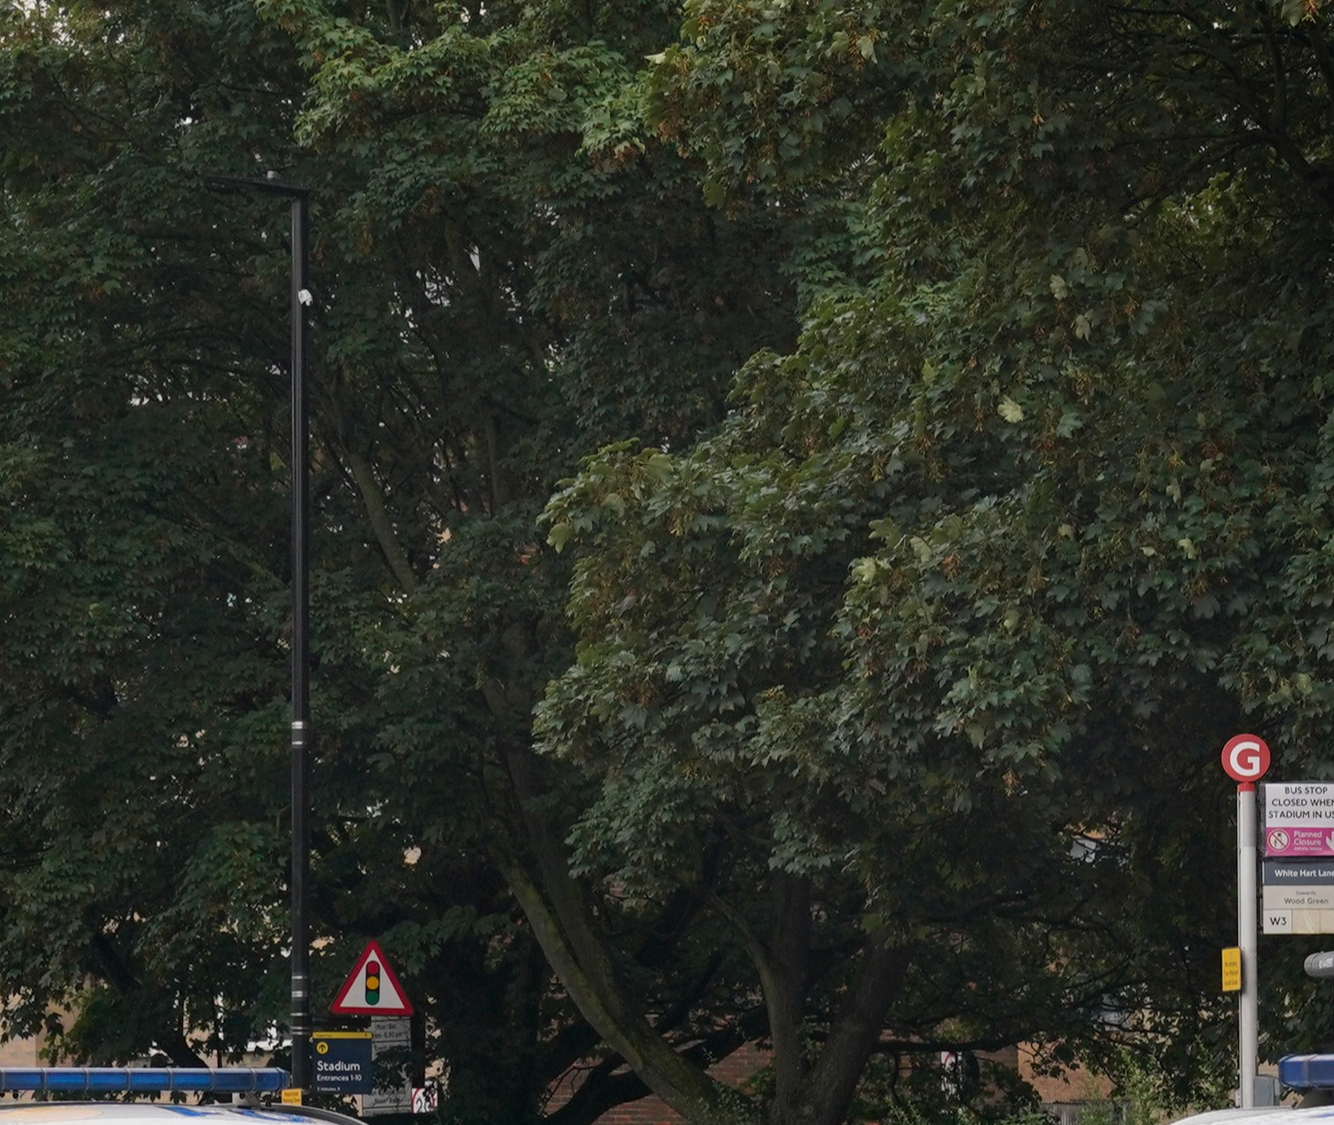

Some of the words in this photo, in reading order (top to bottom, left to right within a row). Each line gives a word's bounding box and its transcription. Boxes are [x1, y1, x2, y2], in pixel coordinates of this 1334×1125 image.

[1230, 741, 1260, 777] G
[1284, 786, 1302, 794] BUS
[1304, 786, 1328, 794] STOP
[1271, 798, 1308, 807] CLOSED
[1268, 810, 1310, 819] STADIUM
[1312, 810, 1322, 819] IN
[1293, 831, 1323, 839] Planned
[1293, 838, 1322, 846] Closure
[1274, 869, 1298, 877] White
[1299, 869, 1317, 877] Hart
[1284, 897, 1305, 905] Wood
[1307, 897, 1329, 905] Green
[1270, 917, 1287, 926] W3
[317, 1060, 361, 1072] Stadium
[317, 1074, 349, 1082] Entrances
[350, 1074, 362, 1082] 1-10
